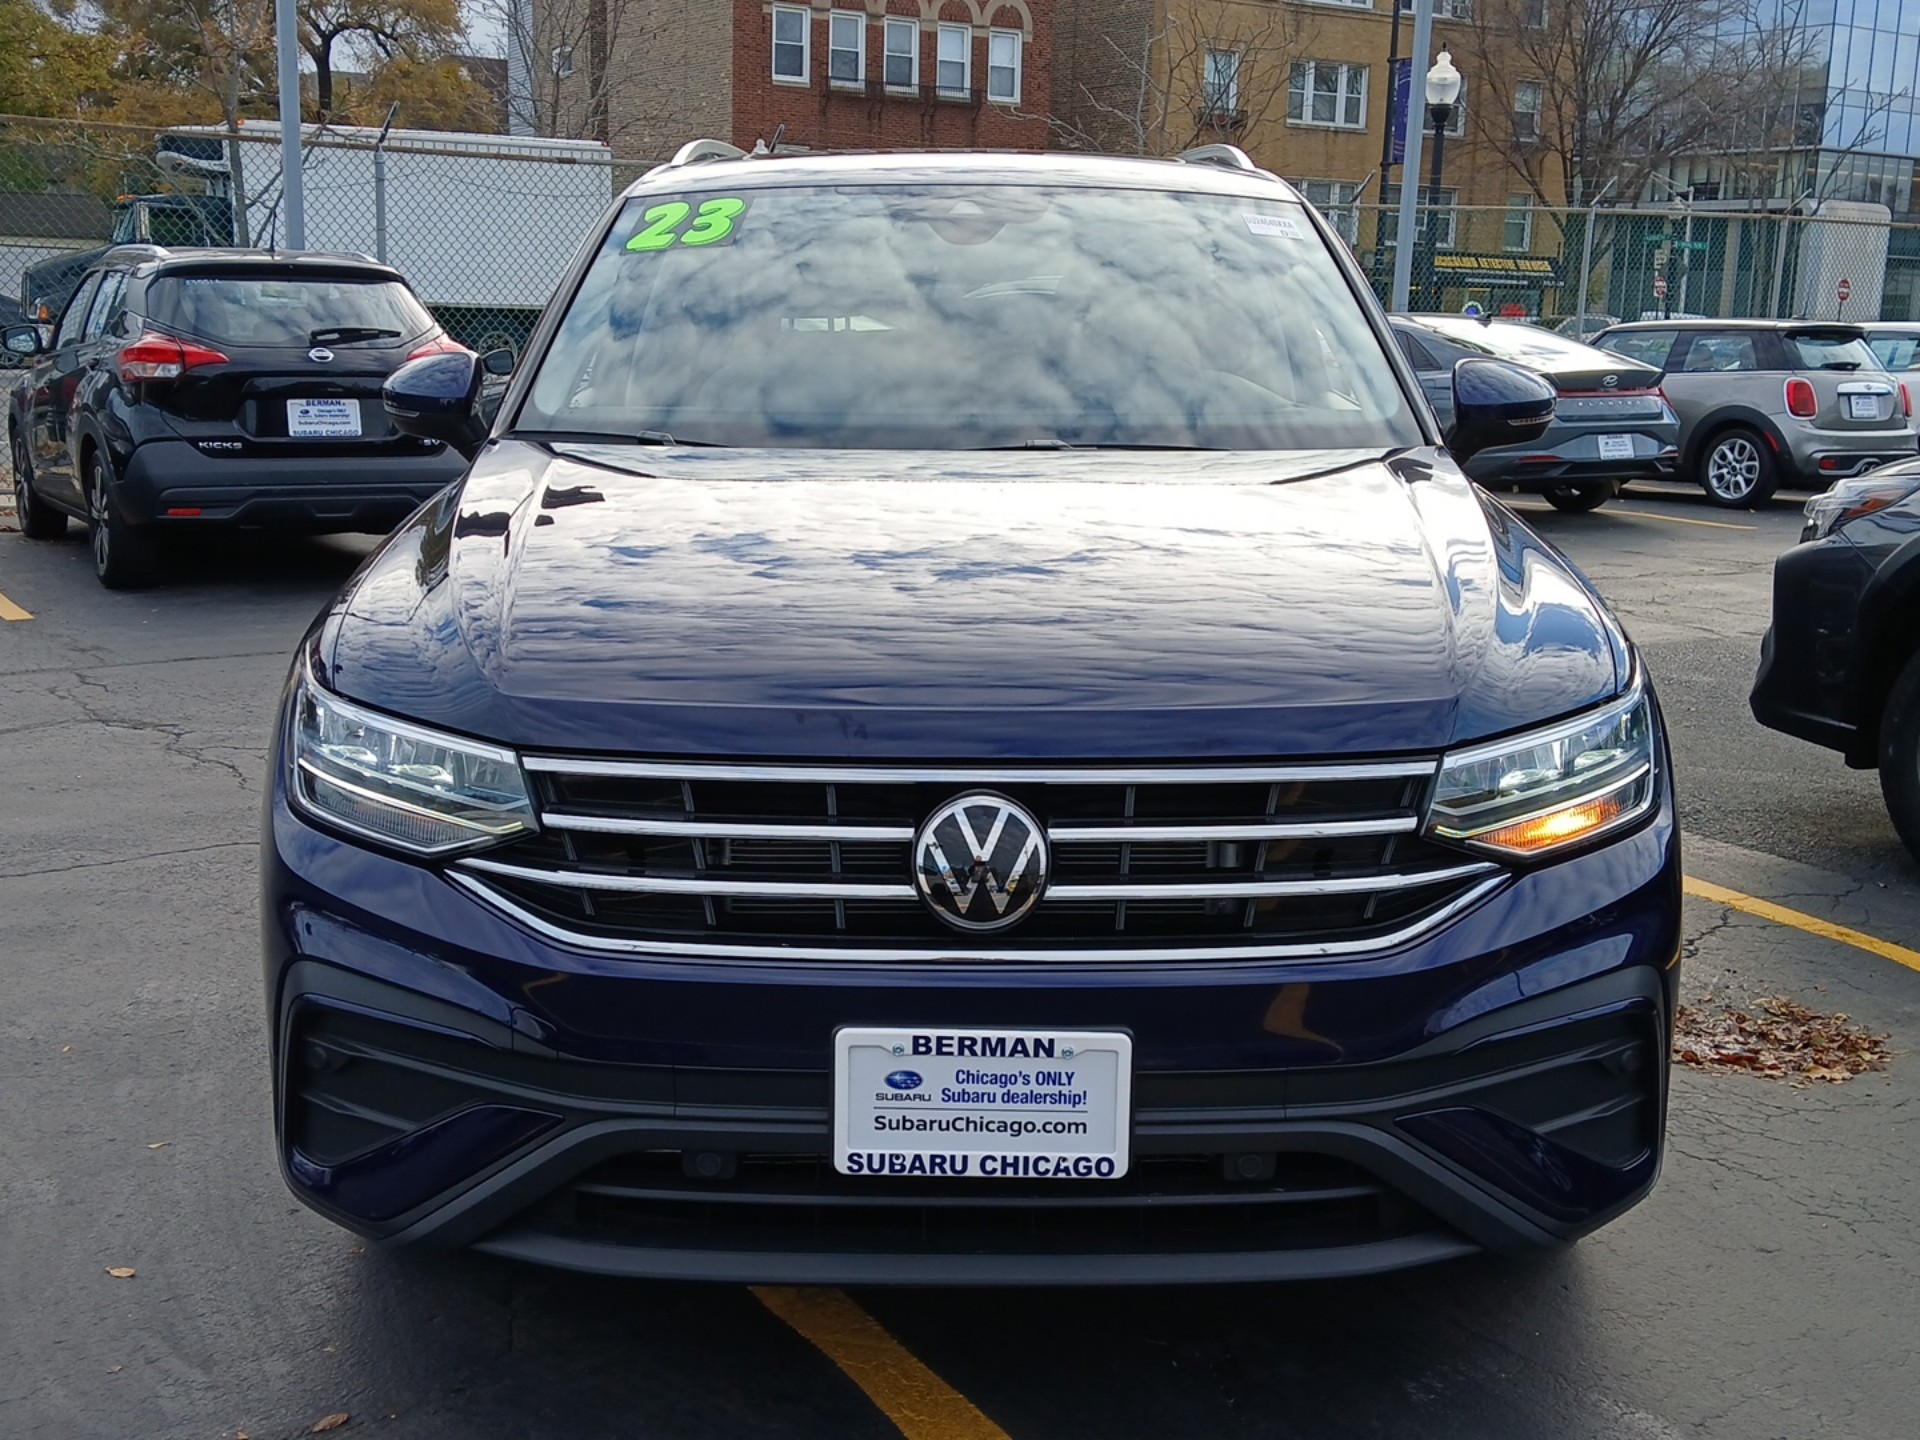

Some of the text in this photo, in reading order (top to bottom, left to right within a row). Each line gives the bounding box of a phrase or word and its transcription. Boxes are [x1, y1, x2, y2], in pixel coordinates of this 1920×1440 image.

[626, 198, 746, 252] 23
[198, 441, 243, 449] KICKS
[911, 1035, 1055, 1058] BERMAN
[955, 1069, 1075, 1088] Chicago's ONLY
[875, 1092, 931, 1102] SUBARU
[941, 1087, 1087, 1108] Subaru dealership!
[874, 1115, 1088, 1137] SubaruChicago.com
[847, 1152, 1115, 1177] SUBARU CHICAGO
